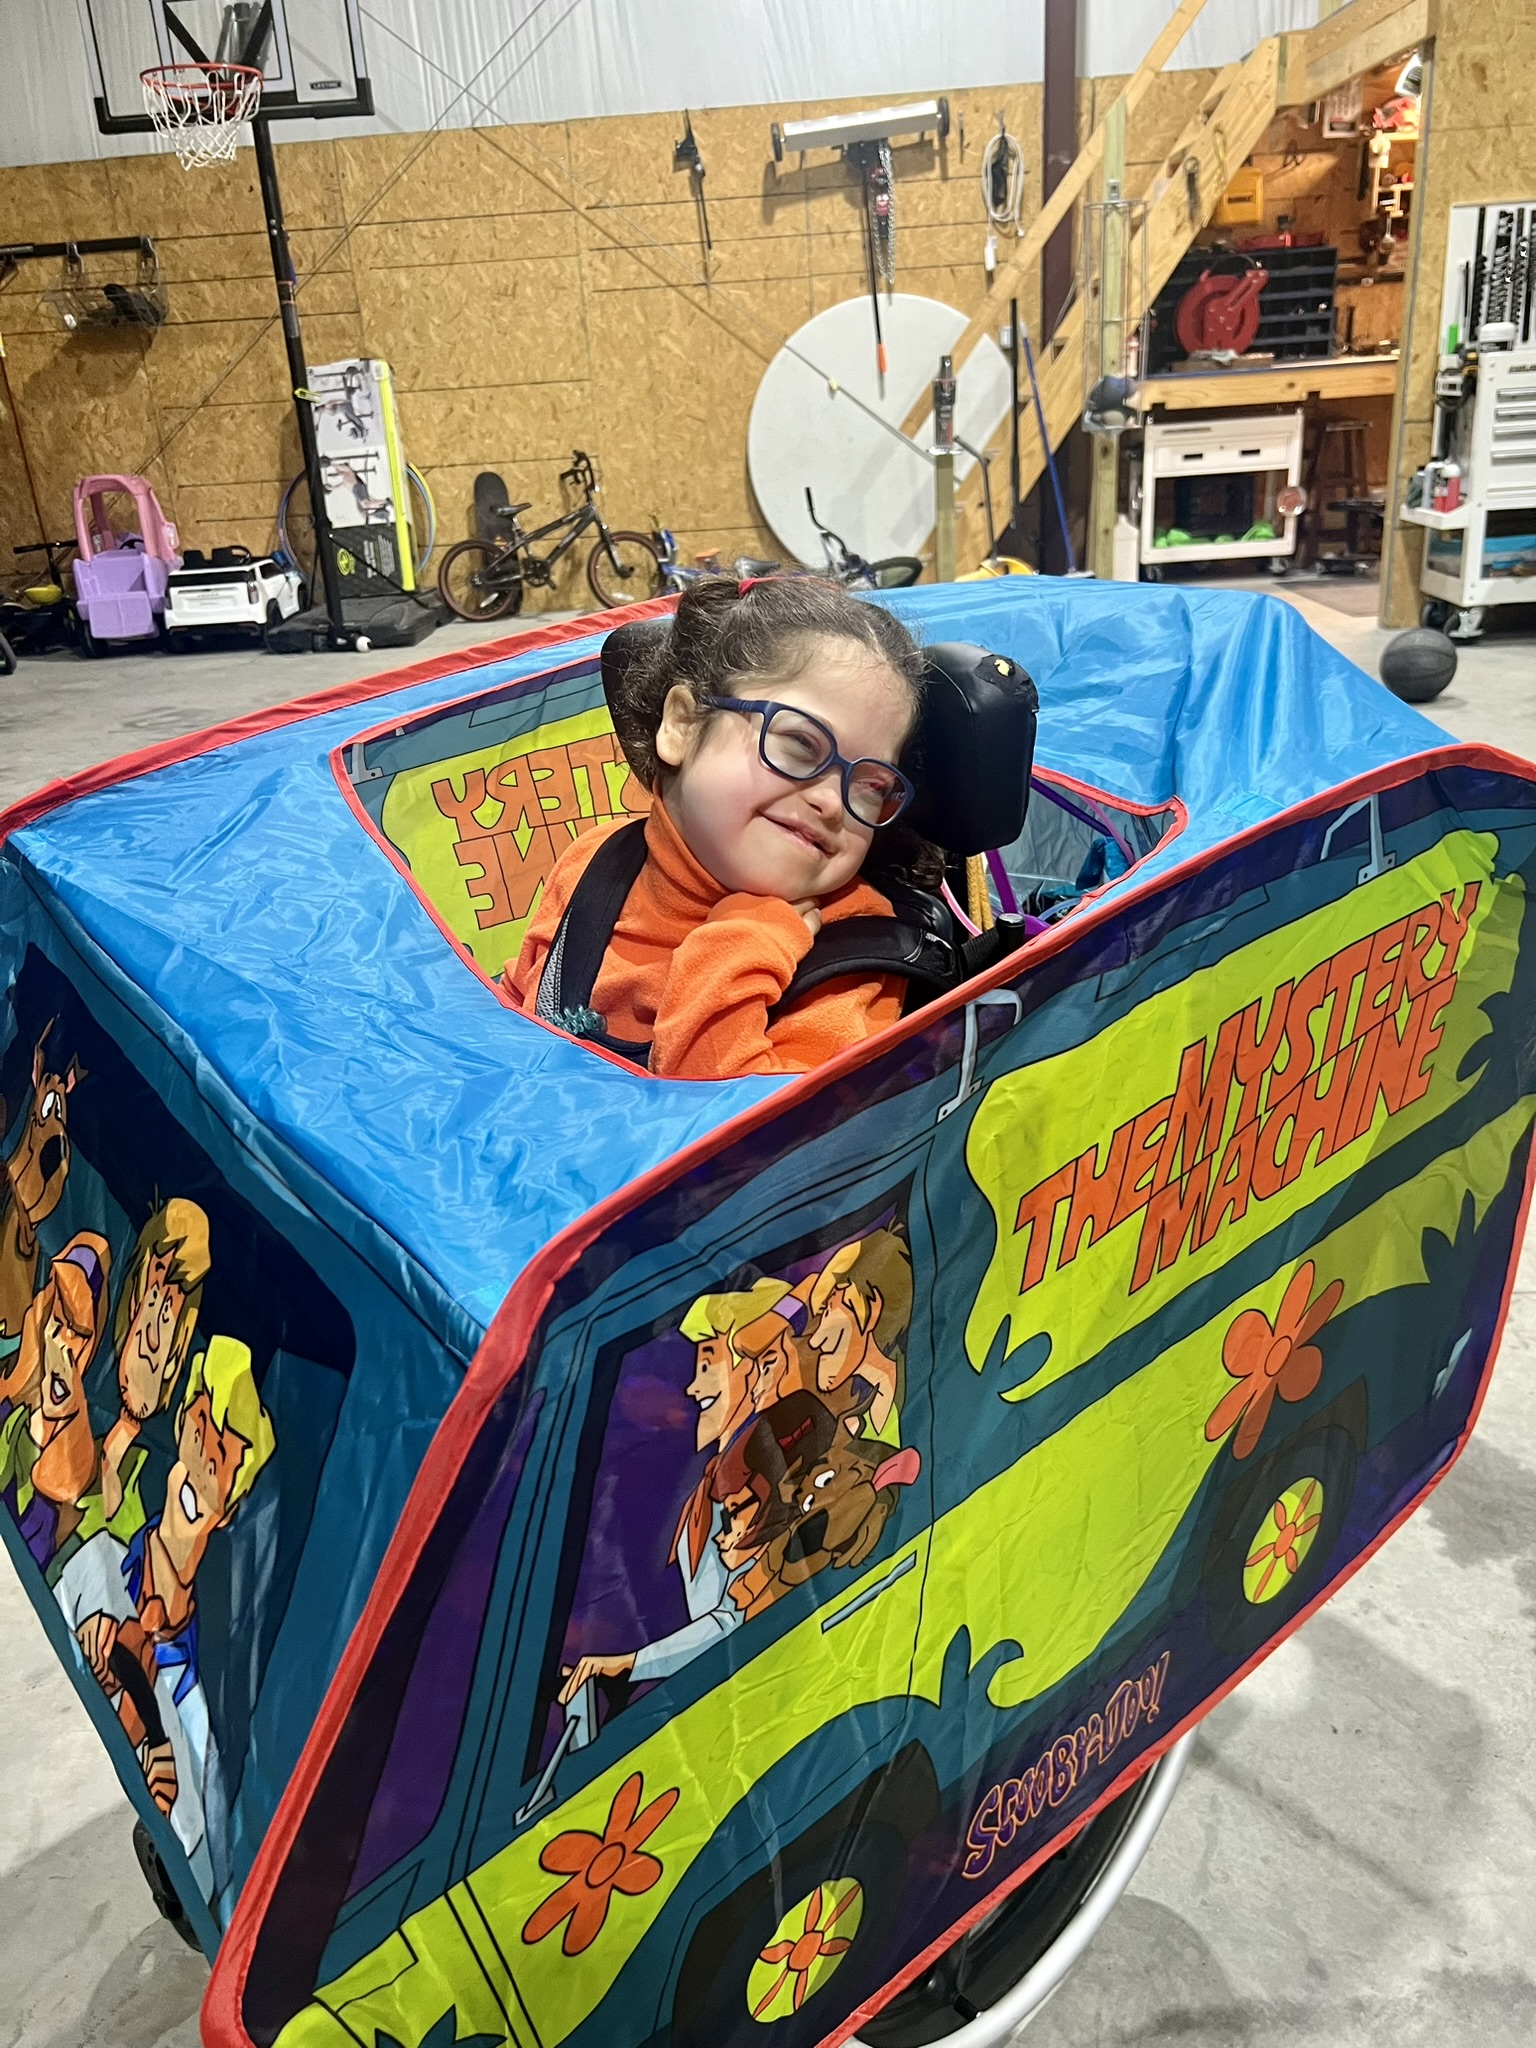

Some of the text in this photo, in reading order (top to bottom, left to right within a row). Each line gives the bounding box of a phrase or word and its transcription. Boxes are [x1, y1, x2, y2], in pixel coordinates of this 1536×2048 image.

[1012, 880, 1482, 1296] THE MYSTERY
[1128, 970, 1458, 1297] MACHINE
[962, 1650, 1171, 1879] SCOOBY-DOO!
